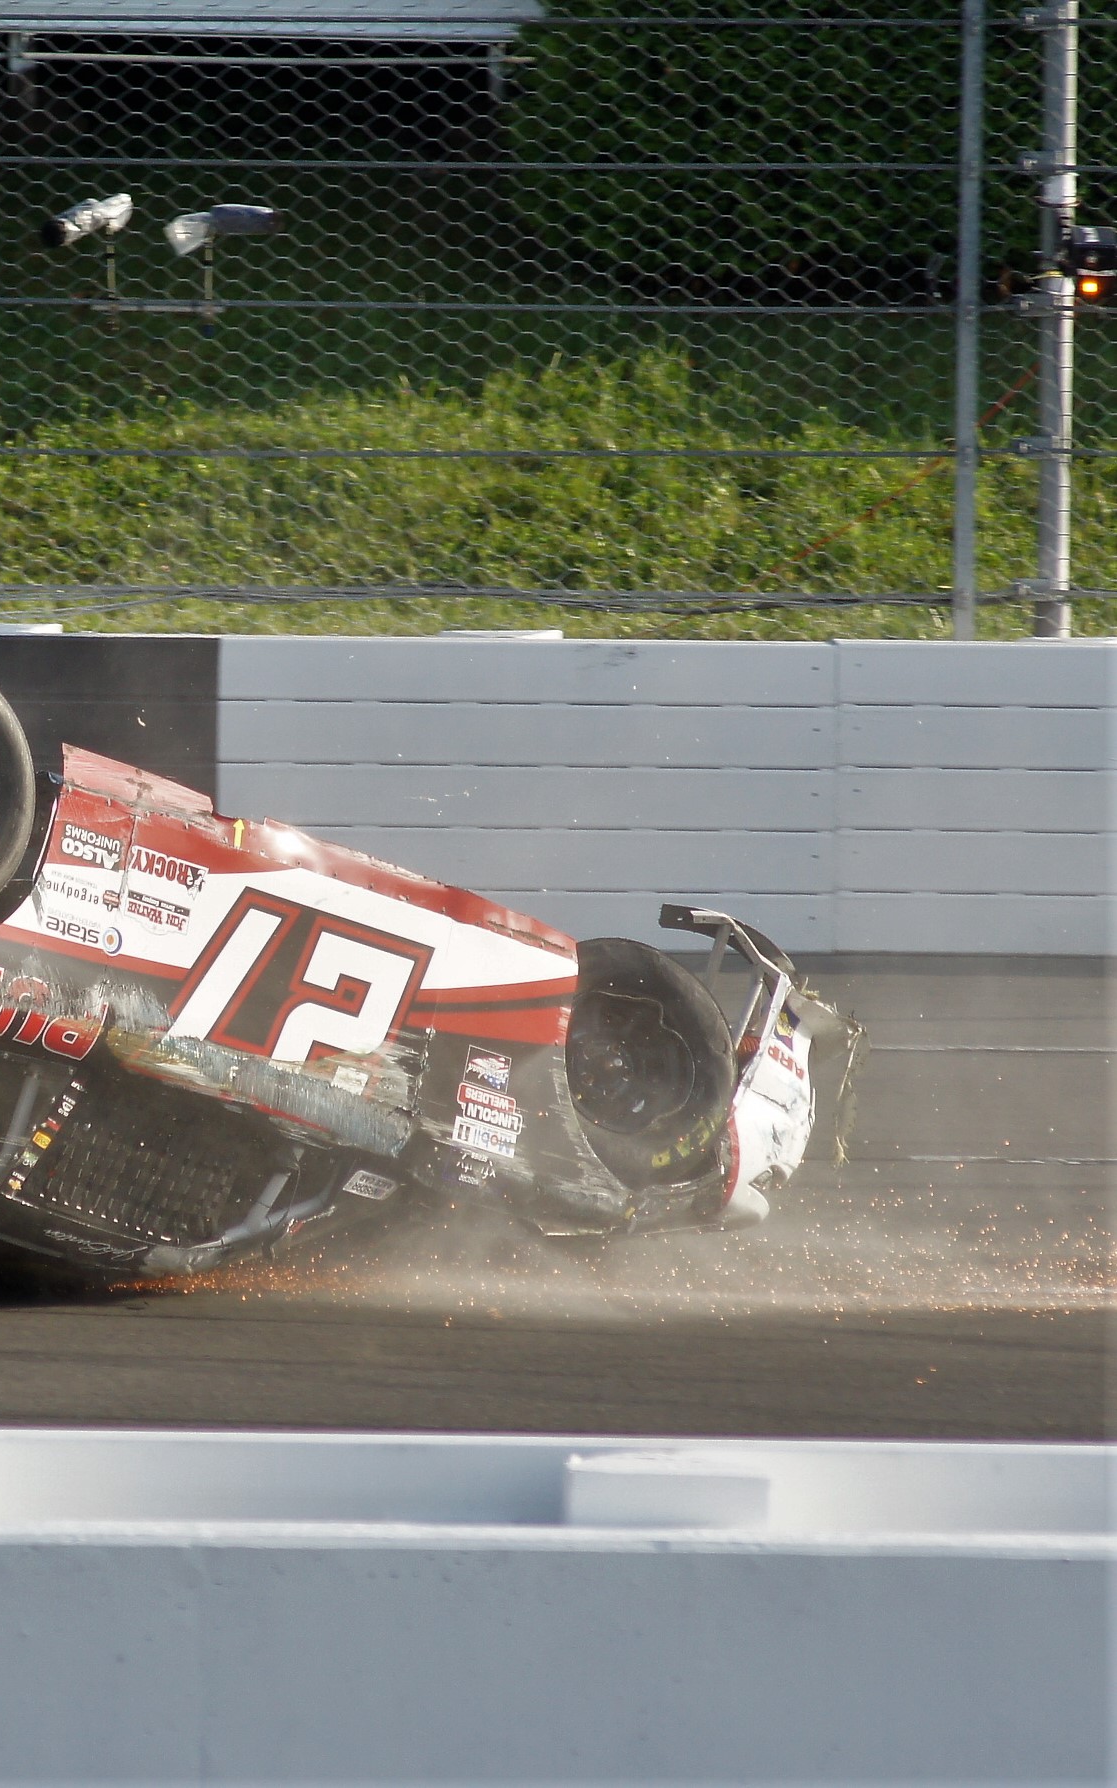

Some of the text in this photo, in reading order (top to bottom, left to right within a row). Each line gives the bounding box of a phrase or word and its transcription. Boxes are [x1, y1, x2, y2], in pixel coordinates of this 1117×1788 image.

[65, 824, 121, 853] UNIFORMS
[61, 837, 121, 870] ALSCO
[131, 849, 190, 886] ROCKY
[46, 880, 99, 905] ergodyne
[46, 915, 101, 944] state
[767, 1045, 805, 1081] ARP
[465, 1087, 510, 1111] WELDERS
[467, 1103, 519, 1131] LINCOLN
[474, 1129, 511, 1154] Mobil
